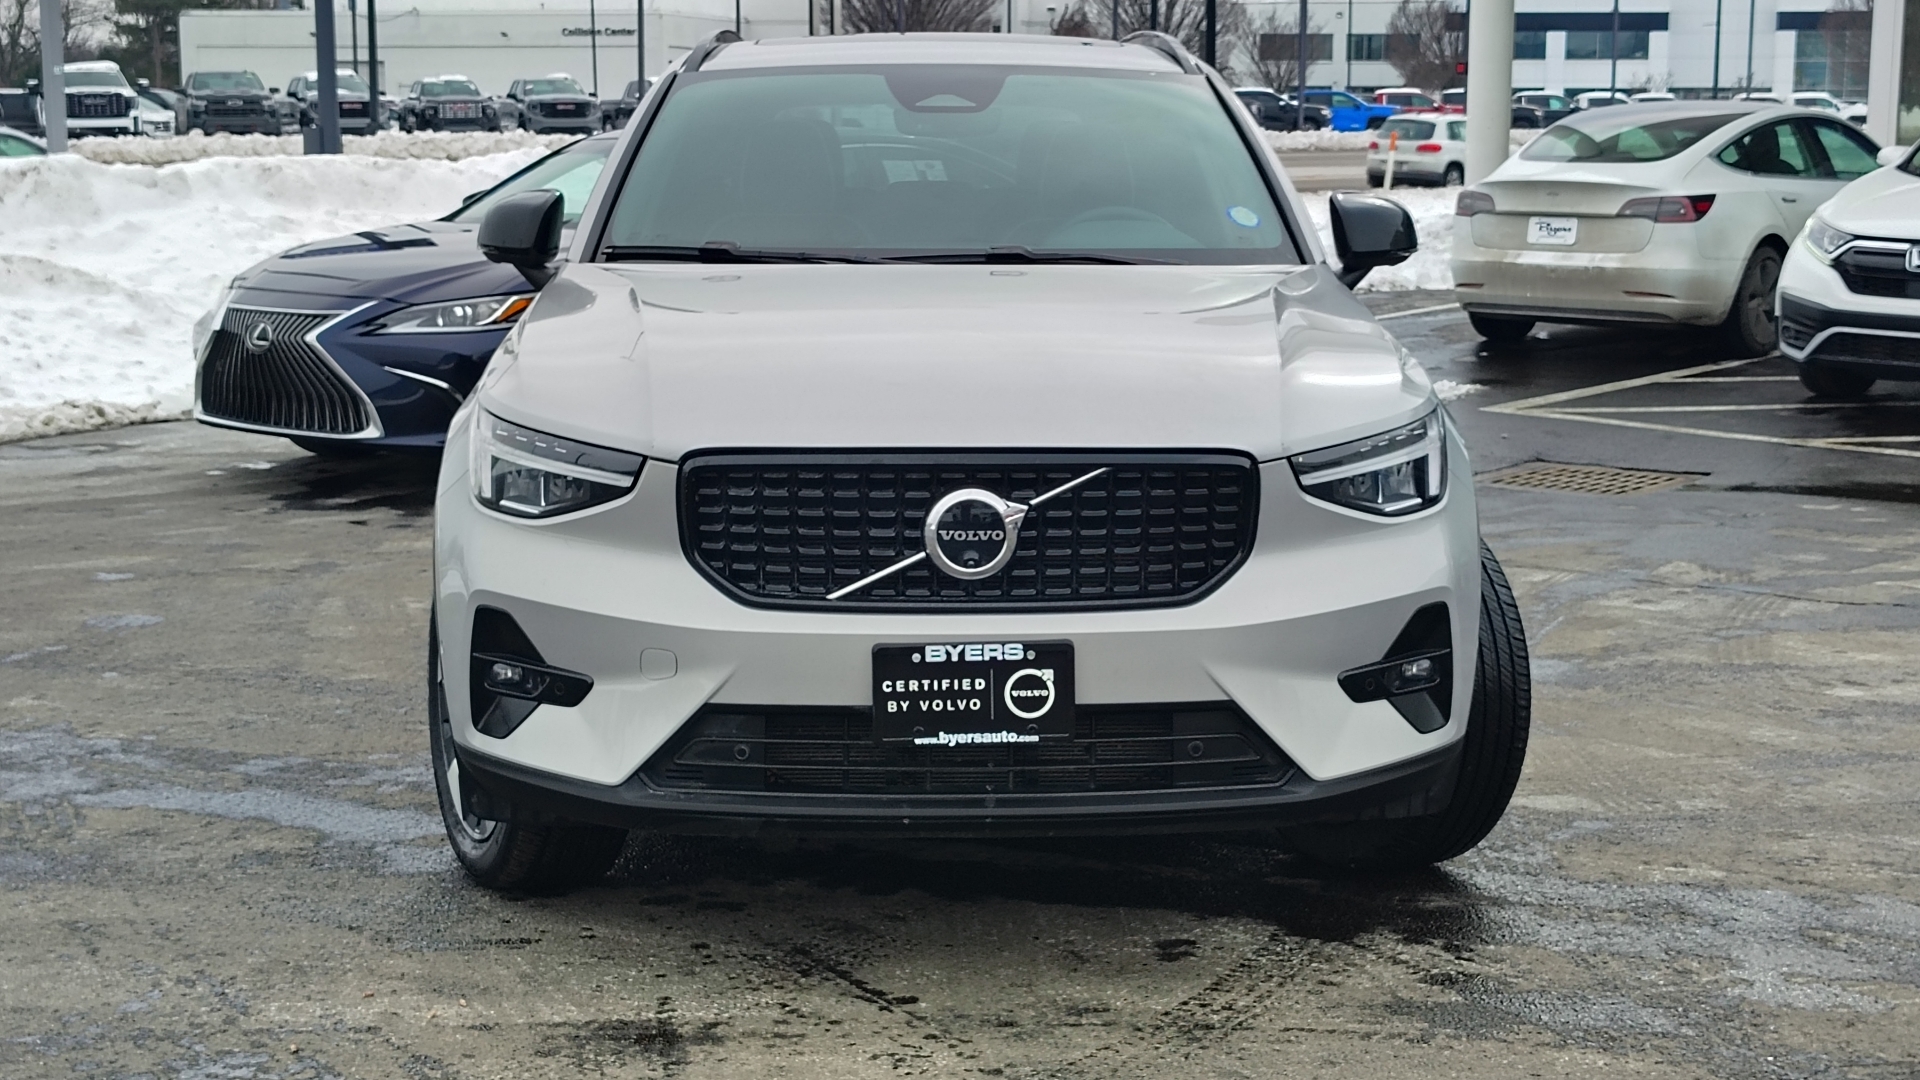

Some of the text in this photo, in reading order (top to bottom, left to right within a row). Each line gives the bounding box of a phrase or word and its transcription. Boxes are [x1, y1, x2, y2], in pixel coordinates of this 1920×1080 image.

[604, 27, 636, 36] Center
[938, 530, 1005, 541] VOLVO
[924, 643, 1024, 662] BYERS
[882, 678, 986, 693] CERTIFIED
[1011, 689, 1049, 697] VOLVO
[887, 698, 981, 713] BY VOLVO
[913, 731, 1039, 746] www.byersauto.com
